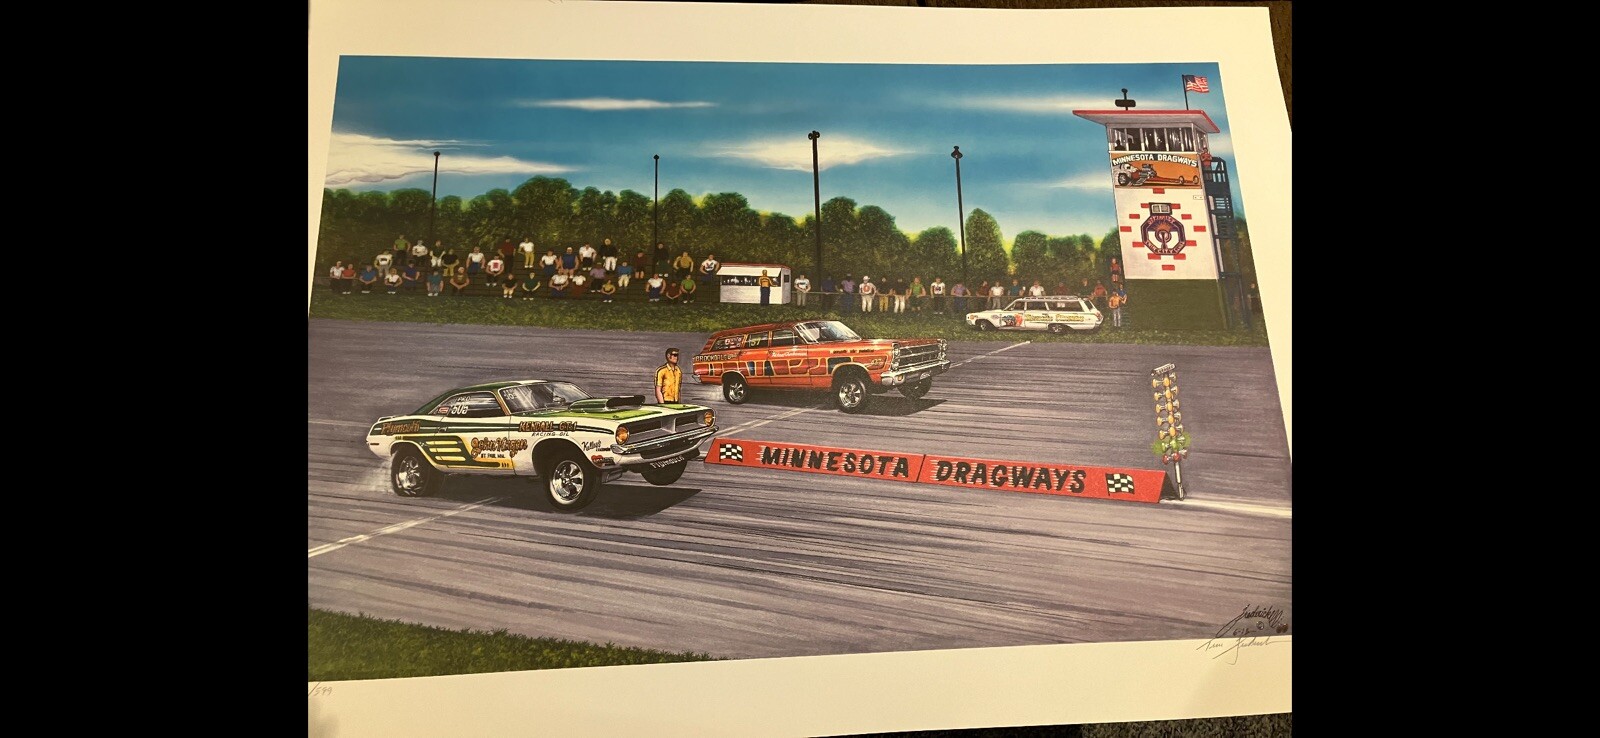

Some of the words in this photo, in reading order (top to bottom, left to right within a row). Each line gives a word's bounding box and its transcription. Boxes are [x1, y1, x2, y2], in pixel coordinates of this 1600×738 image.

[1112, 154, 1154, 166] MINNESOTA
[1157, 154, 1198, 167] DRAGWAYS
[381, 420, 421, 435] Plymouth
[519, 421, 554, 432] KENDALL
[760, 446, 910, 478] MINNESOTA
[933, 460, 1087, 494] DRAGWAYS
